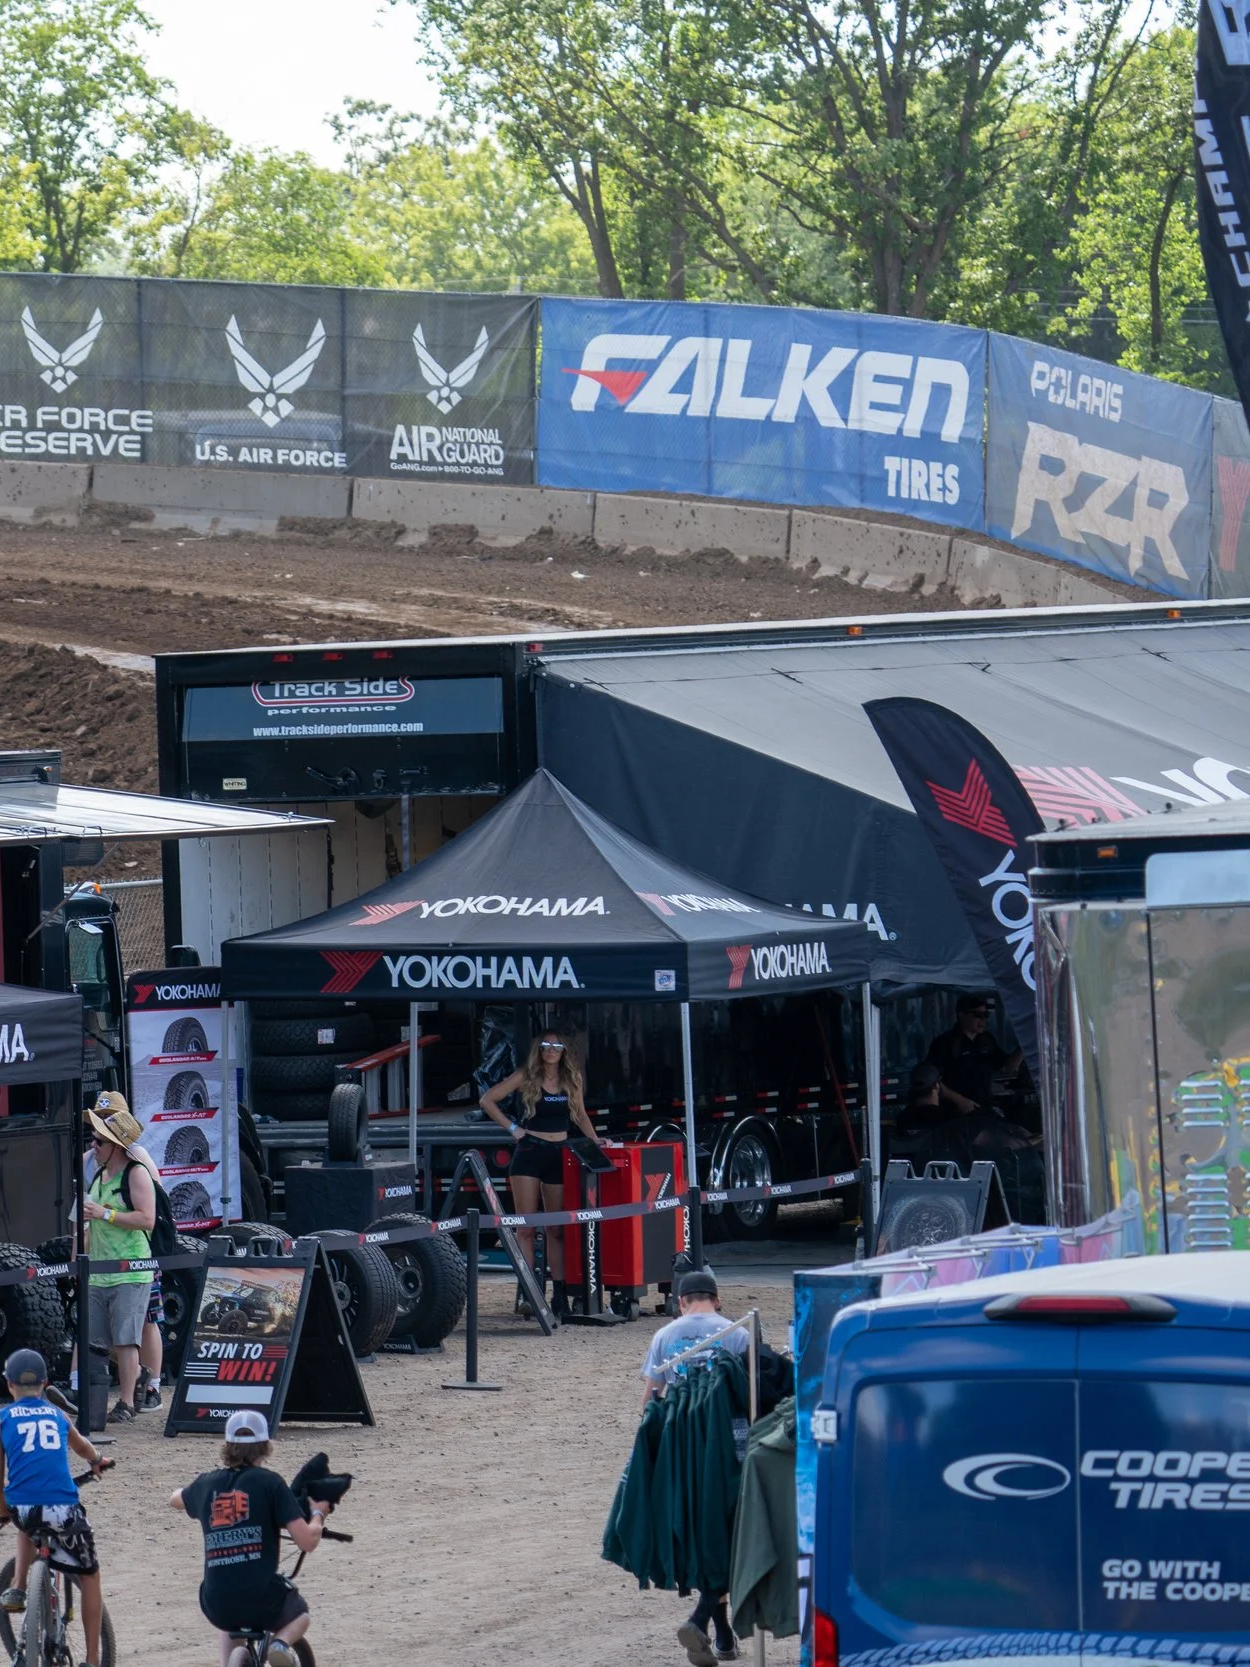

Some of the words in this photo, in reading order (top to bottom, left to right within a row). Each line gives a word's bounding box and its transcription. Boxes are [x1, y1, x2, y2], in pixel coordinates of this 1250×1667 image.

[568, 333, 970, 444] FALKEN
[1029, 359, 1123, 424] POLARIS
[36, 406, 154, 433] FORCE
[389, 424, 444, 462] AIR
[442, 427, 503, 444] NATIONAL
[195, 443, 233, 464] U.S.
[238, 445, 274, 465] AIR
[277, 448, 348, 468] FORCE
[443, 443, 505, 465] GUARD
[390, 462, 438, 473] GoANG.com
[883, 455, 960, 505] TIRES
[1010, 420, 1189, 581] RZR
[269, 679, 338, 698] Track
[344, 677, 399, 696] Side
[267, 704, 397, 716] performance
[253, 721, 424, 738] www.tracksideperformance.com
[418, 895, 606, 919] YOKOHAMA
[660, 893, 762, 914] YOKOHAMA
[751, 941, 831, 980] YOKOHAMA
[383, 954, 580, 989] YOKOHAMA
[833, 1173, 856, 1185] YOKOHAMA
[384, 1185, 413, 1199] YOKOHAMA
[706, 1191, 728, 1202] YOKOHAMA
[770, 1185, 793, 1196] YOKOHAMA
[655, 1197, 680, 1210] YOKOHAMA
[438, 1217, 462, 1231] YOKOHAMA
[500, 1216, 526, 1226] YOKOHAMA
[577, 1210, 603, 1221] YOKOHAMA
[365, 1231, 390, 1243] YOKOHAMA
[36, 1263, 69, 1278] YOKOHAMA
[128, 1259, 160, 1270] YOKOHAMA
[197, 1342, 240, 1359] SPIN
[242, 1343, 263, 1360] TO
[383, 1342, 412, 1351] YOKOHAMA
[217, 1360, 277, 1382] WIN!
[9, 1405, 58, 1418] RICKERT
[209, 1408, 238, 1418] YOKOH
[16, 1420, 61, 1454] 76
[1109, 1481, 1250, 1511] TIRES
[1102, 1558, 1142, 1579] GO
[1148, 1560, 1221, 1580] WITH
[1102, 1580, 1158, 1600] THE
[1165, 1581, 1250, 1602] COOPE
